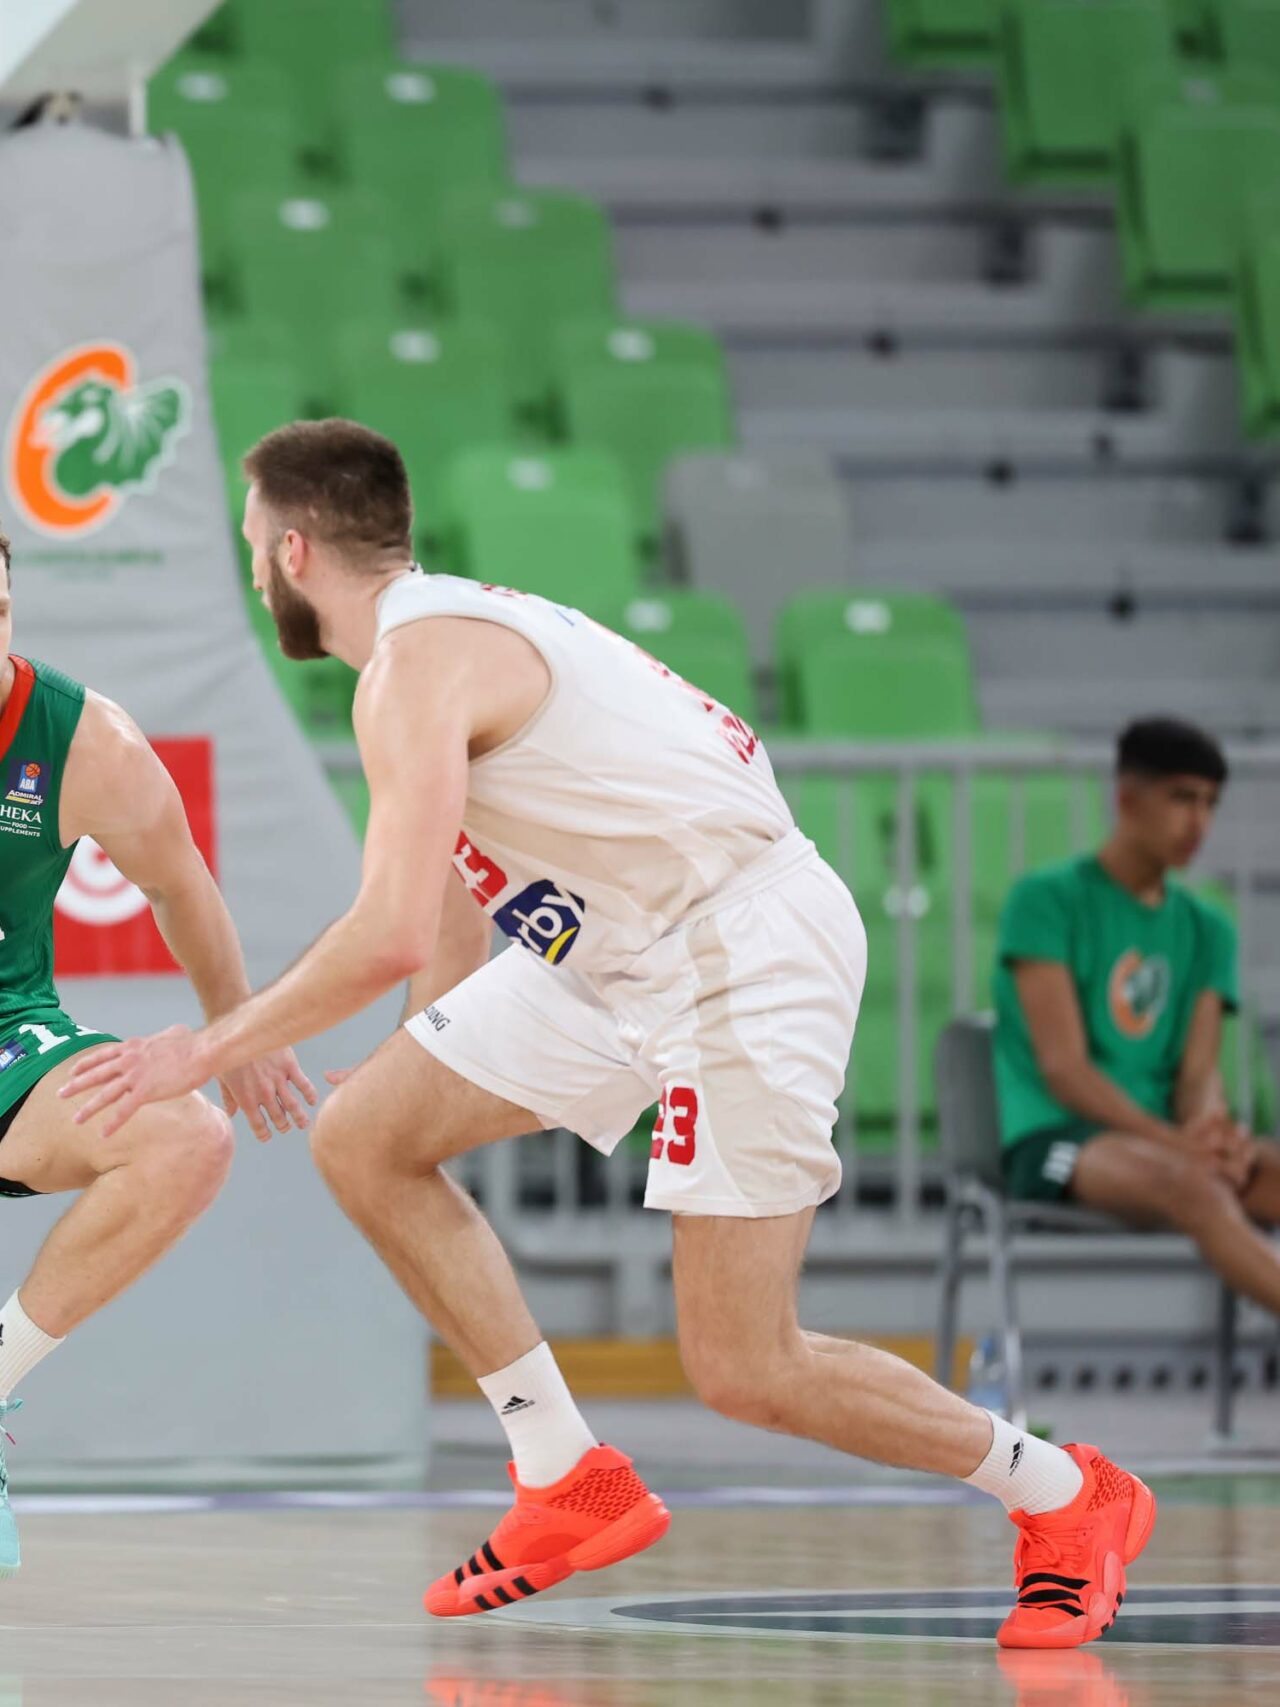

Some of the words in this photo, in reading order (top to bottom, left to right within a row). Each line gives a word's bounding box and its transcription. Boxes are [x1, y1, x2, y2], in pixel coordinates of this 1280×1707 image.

[8, 790, 43, 800] ADMIRAL
[0, 804, 42, 824] HEKA
[11, 821, 28, 829] FOOD
